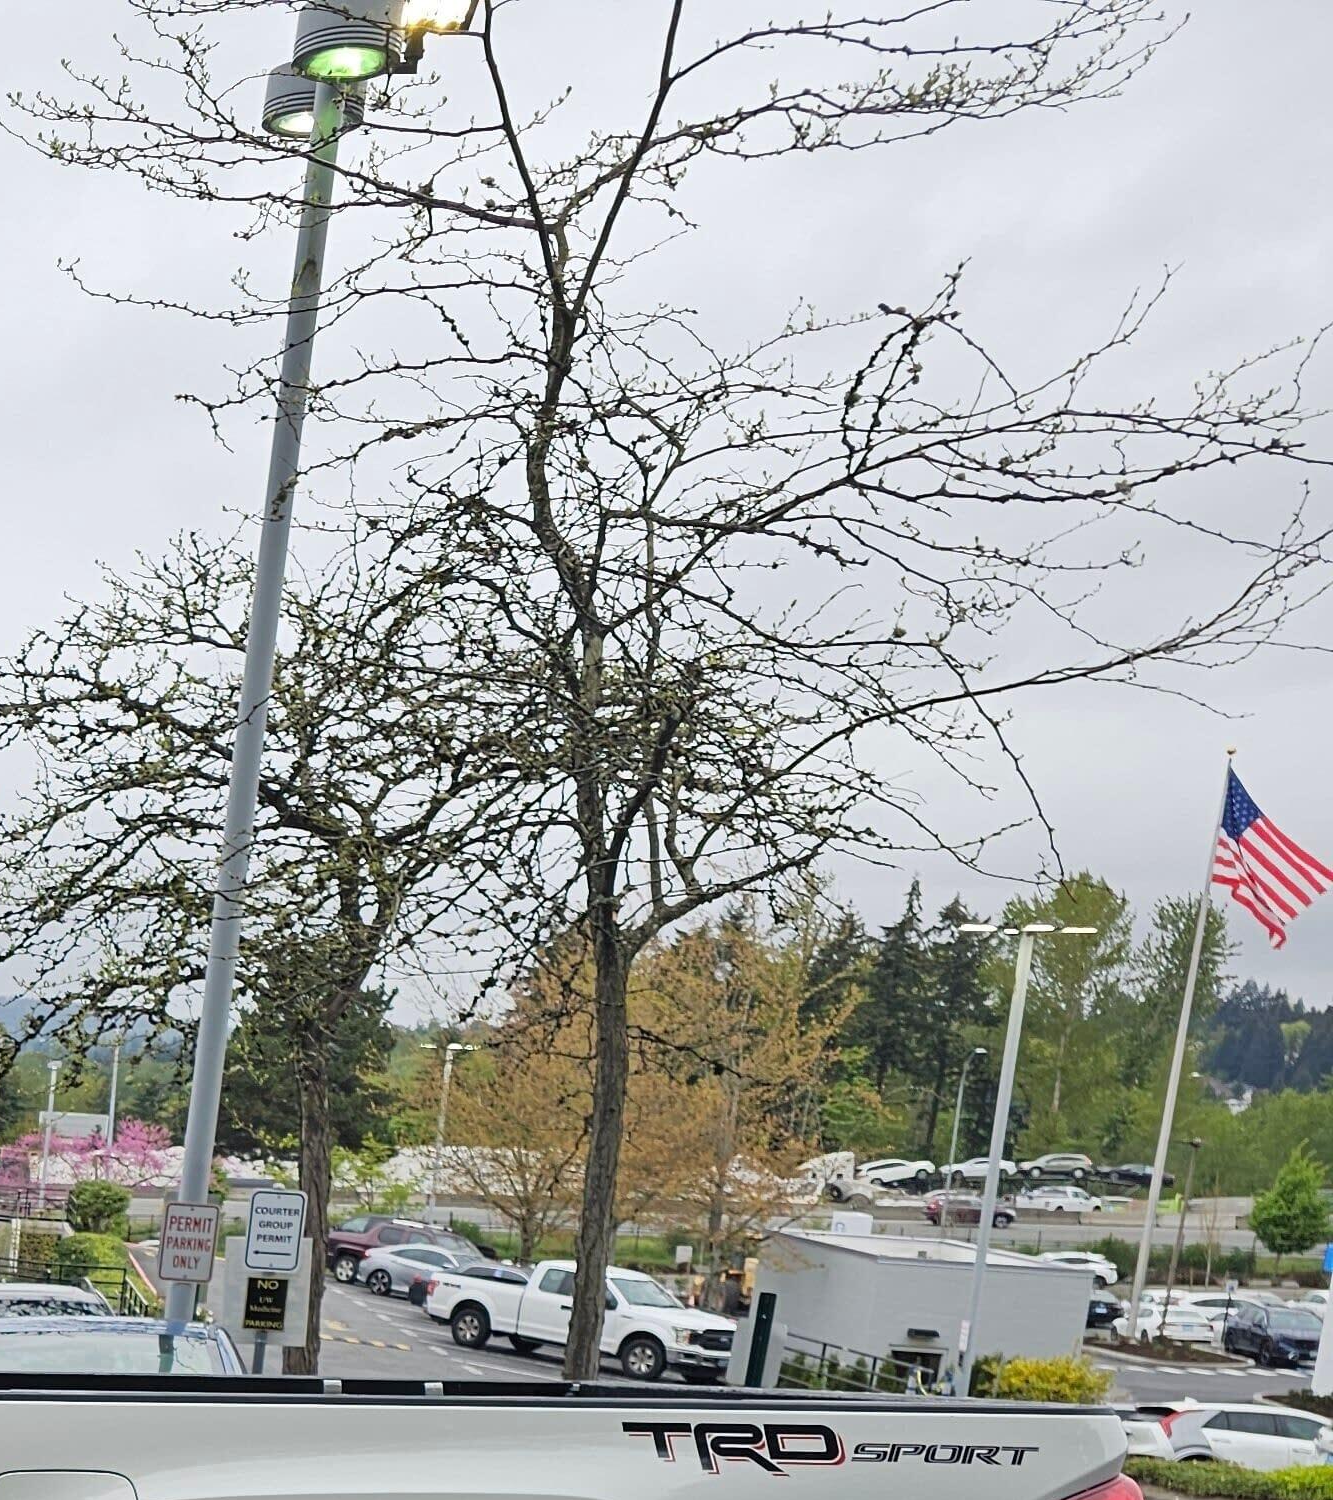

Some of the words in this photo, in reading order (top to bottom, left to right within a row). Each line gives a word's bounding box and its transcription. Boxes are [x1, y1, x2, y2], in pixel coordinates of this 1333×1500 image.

[255, 1206, 301, 1217] COURTER
[169, 1215, 214, 1234] PERMIT
[258, 1220, 294, 1230] GROUP
[166, 1236, 212, 1252] PARKING
[256, 1233, 293, 1244] PERMIT
[173, 1255, 201, 1270] ONLY
[257, 1280, 280, 1290] NO
[244, 1319, 283, 1329] PARKING
[622, 1421, 846, 1477] TRD
[851, 1443, 1040, 1466] SPORT
